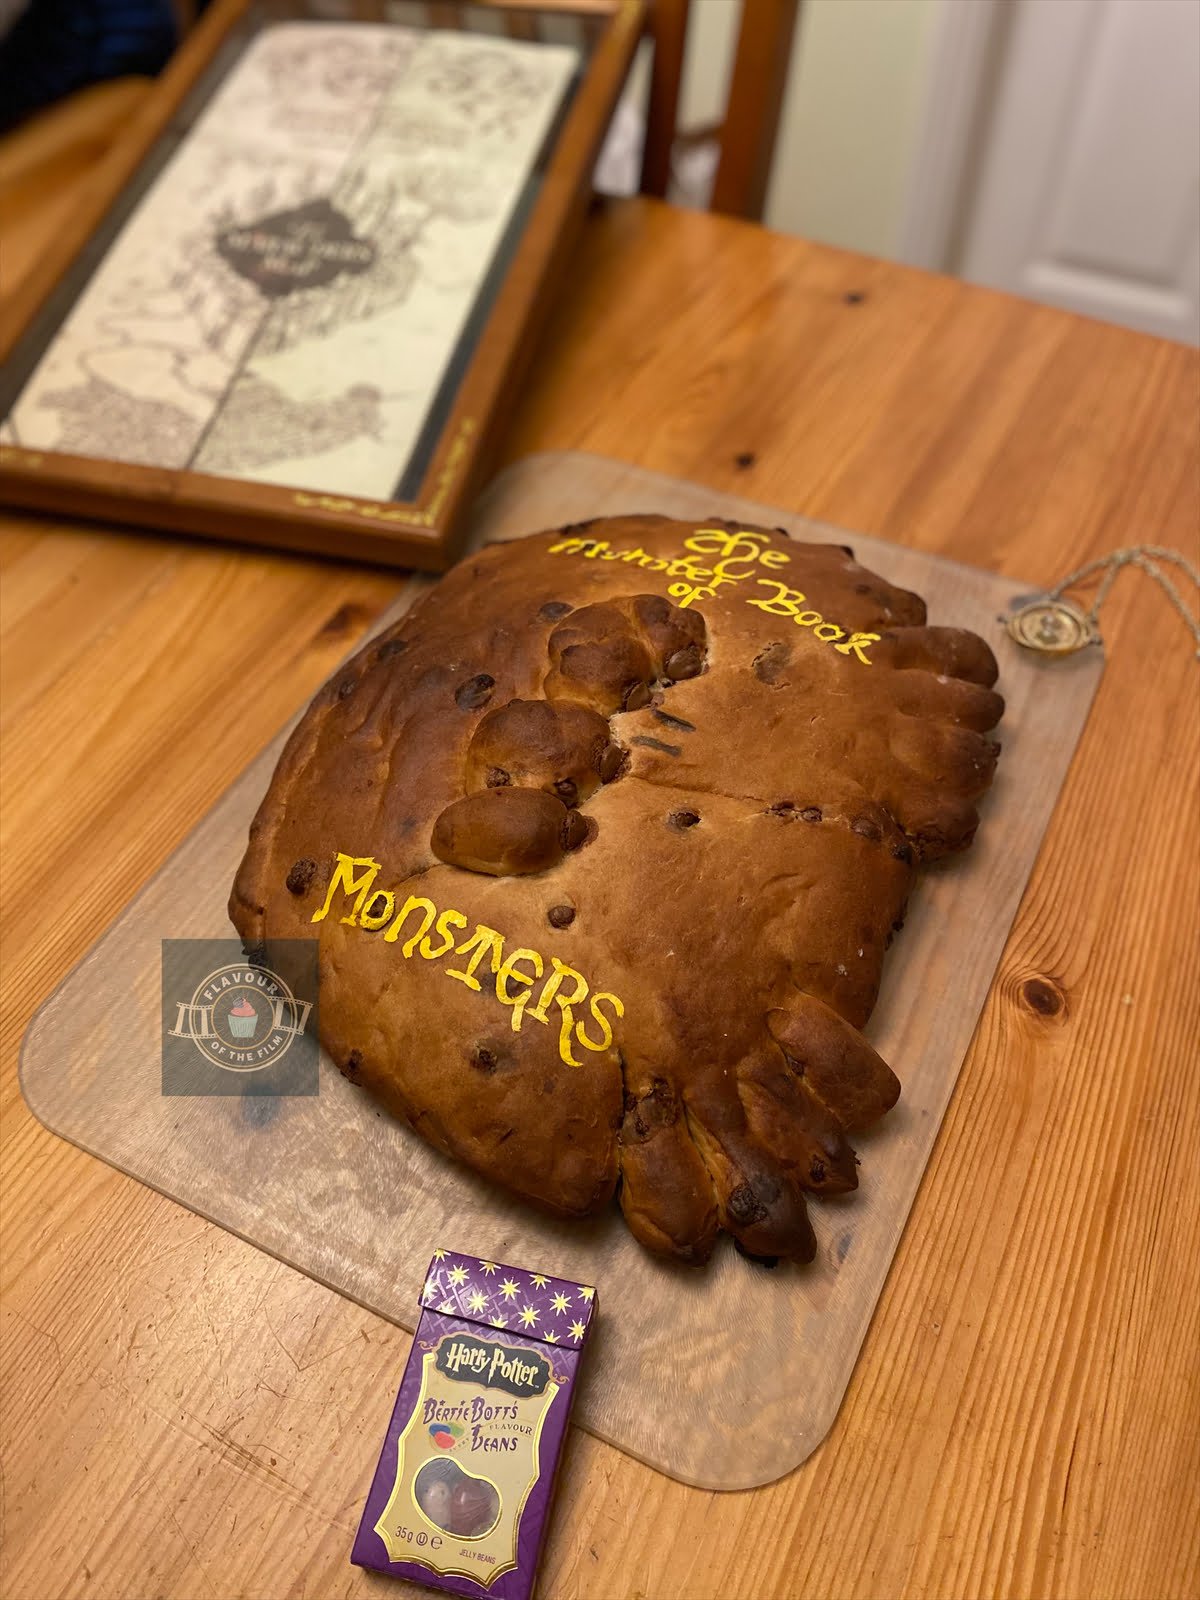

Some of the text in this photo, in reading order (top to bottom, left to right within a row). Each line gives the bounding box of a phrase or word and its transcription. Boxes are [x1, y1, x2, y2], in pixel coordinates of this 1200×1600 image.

[667, 582, 717, 609] of
[746, 579, 881, 665] Book
[446, 1343, 539, 1387] Harry Potter
[489, 1424, 533, 1436] FLAVOUR
[395, 1525, 414, 1543] 35g
[459, 1549, 497, 1565] JELLY BEANS
